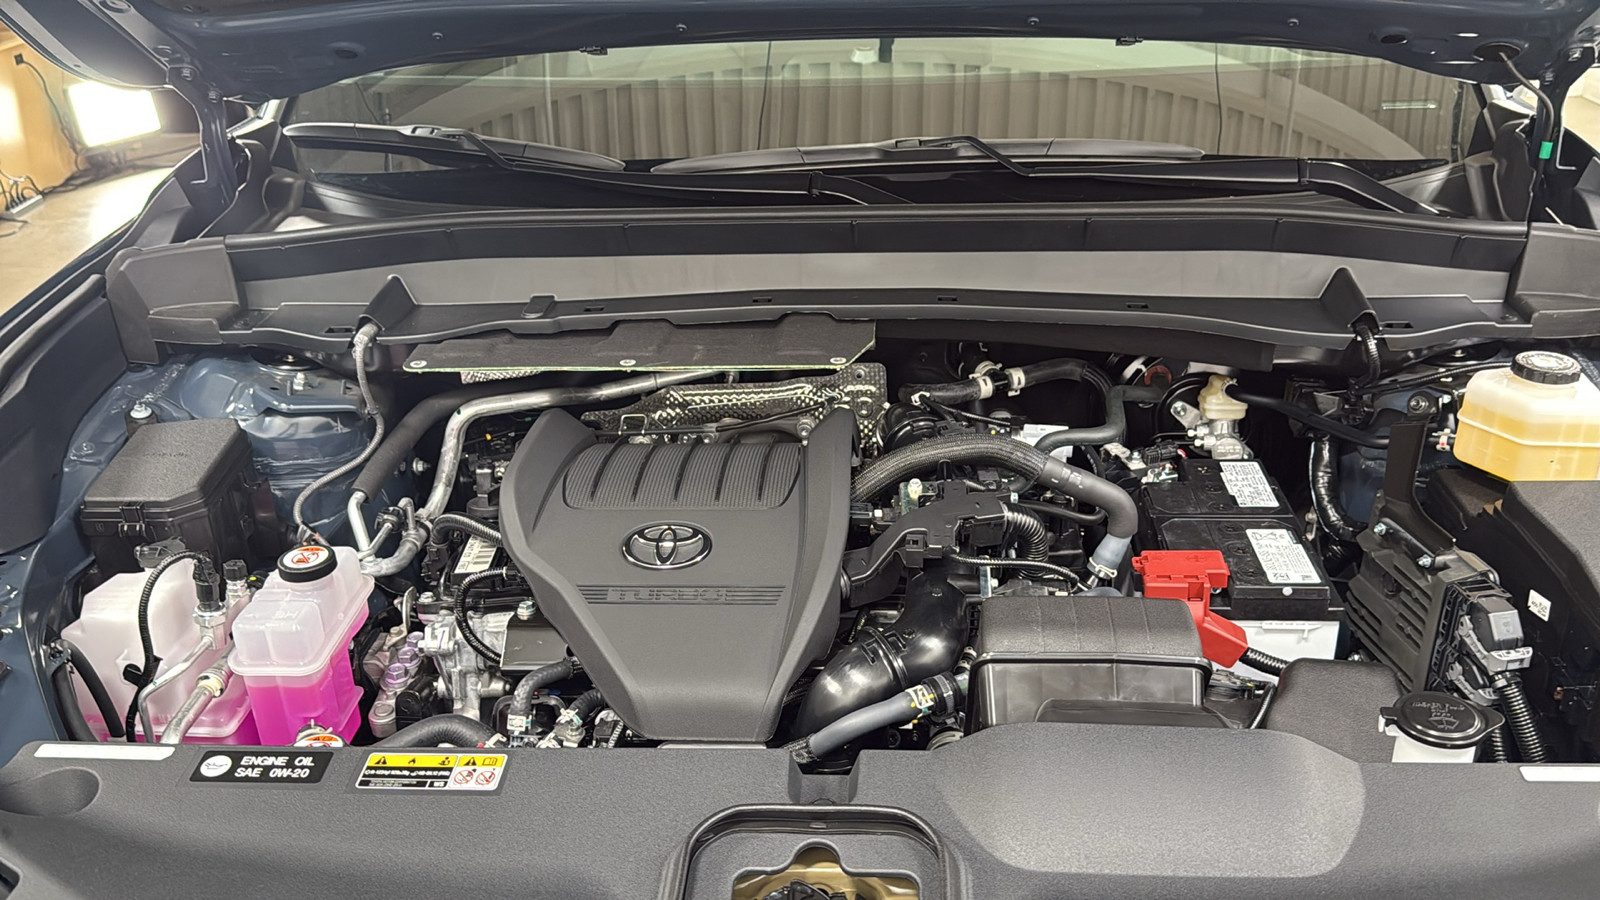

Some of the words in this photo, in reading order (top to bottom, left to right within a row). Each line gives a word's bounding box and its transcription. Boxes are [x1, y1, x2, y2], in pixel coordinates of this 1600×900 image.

[610, 587, 723, 601] TURBO
[240, 756, 289, 766] ENGINE
[294, 756, 315, 766] OIL
[234, 768, 263, 777] SAE
[269, 768, 311, 778] 0W-20
